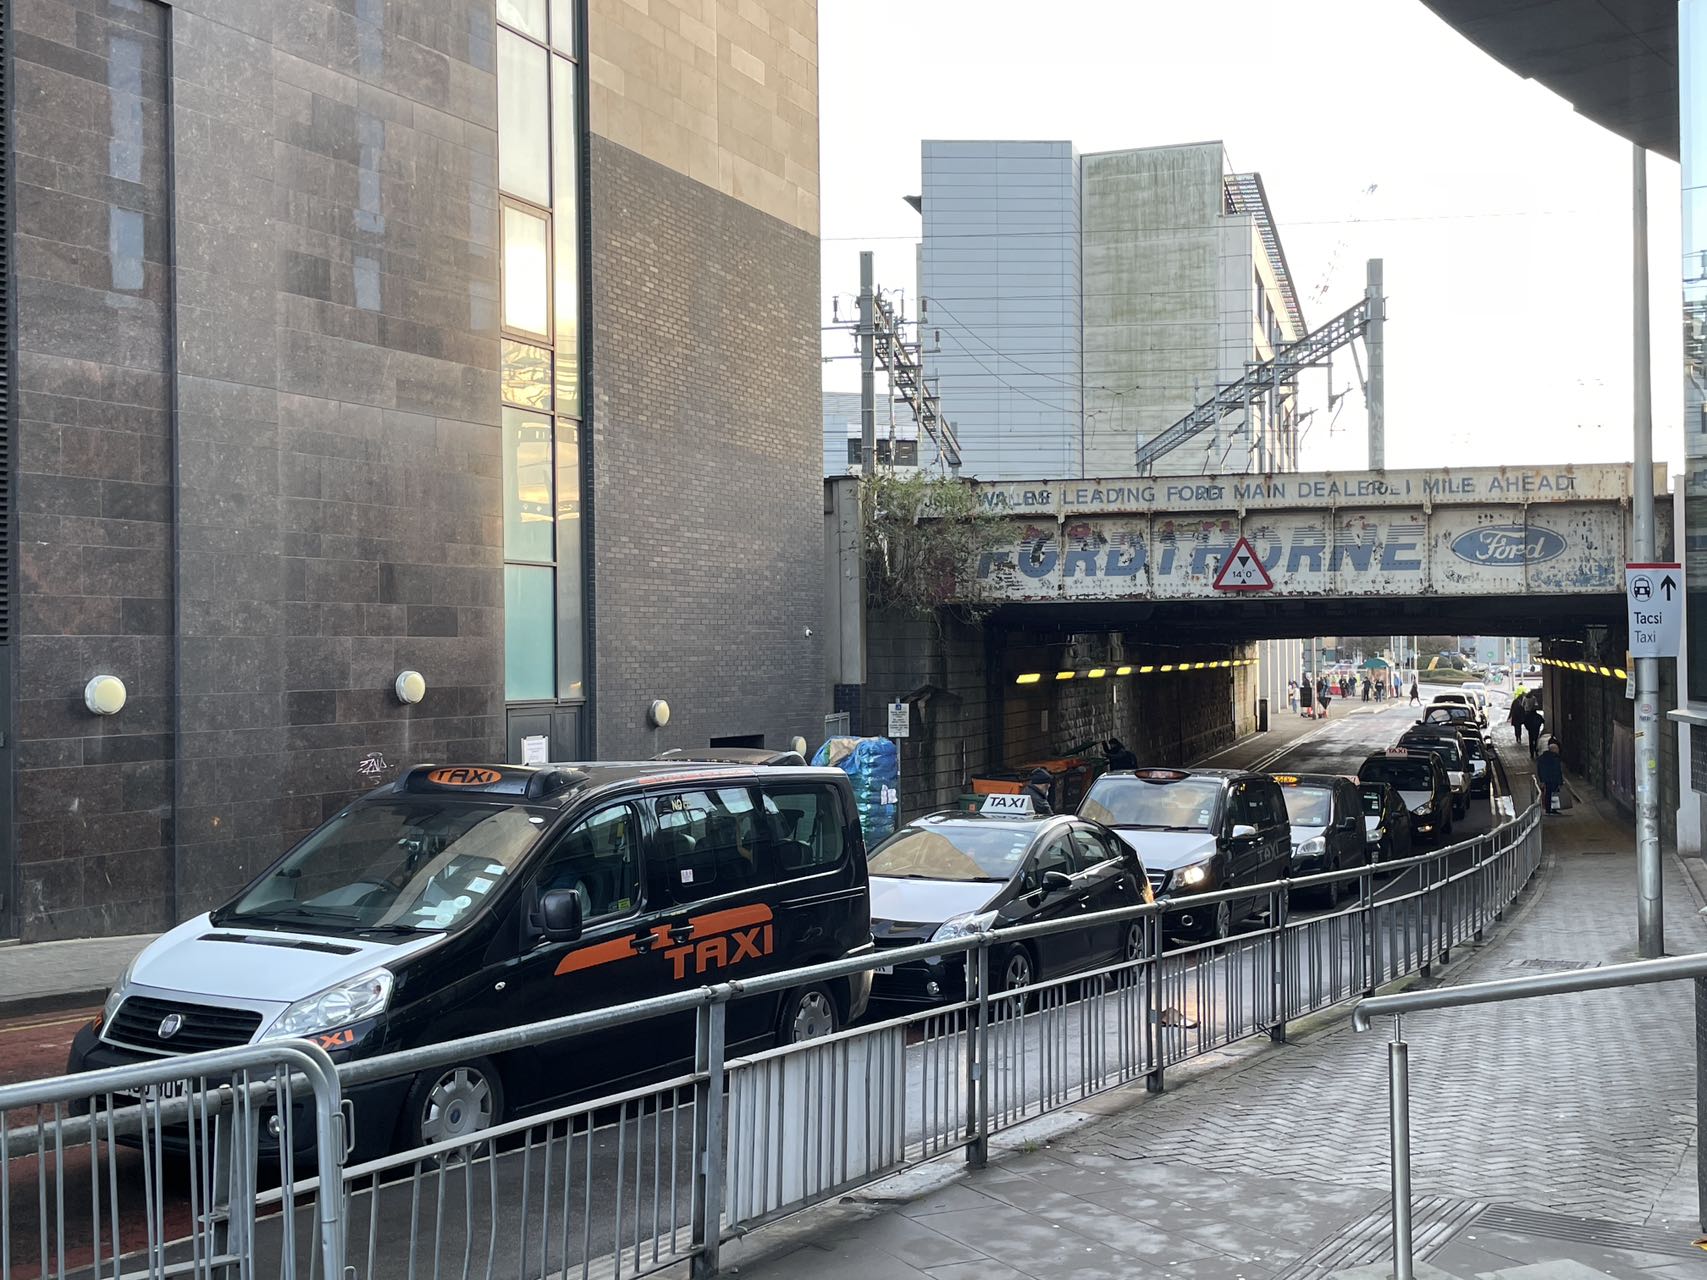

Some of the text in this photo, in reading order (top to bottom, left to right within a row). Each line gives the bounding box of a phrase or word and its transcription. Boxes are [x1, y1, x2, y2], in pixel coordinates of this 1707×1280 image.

[1063, 487, 1155, 505] LEADING
[1234, 483, 1286, 499] MAIN
[1423, 477, 1474, 494] MILE
[1488, 475, 1570, 493] AHEAD
[1476, 530, 1545, 560] Ford
[1634, 612, 1662, 624] Tacsi
[1634, 630, 1656, 643] Taxi
[437, 769, 493, 783] TAXI
[990, 796, 1026, 808] TAXI
[1257, 840, 1279, 862] TAXI
[664, 924, 773, 980] TAXI
